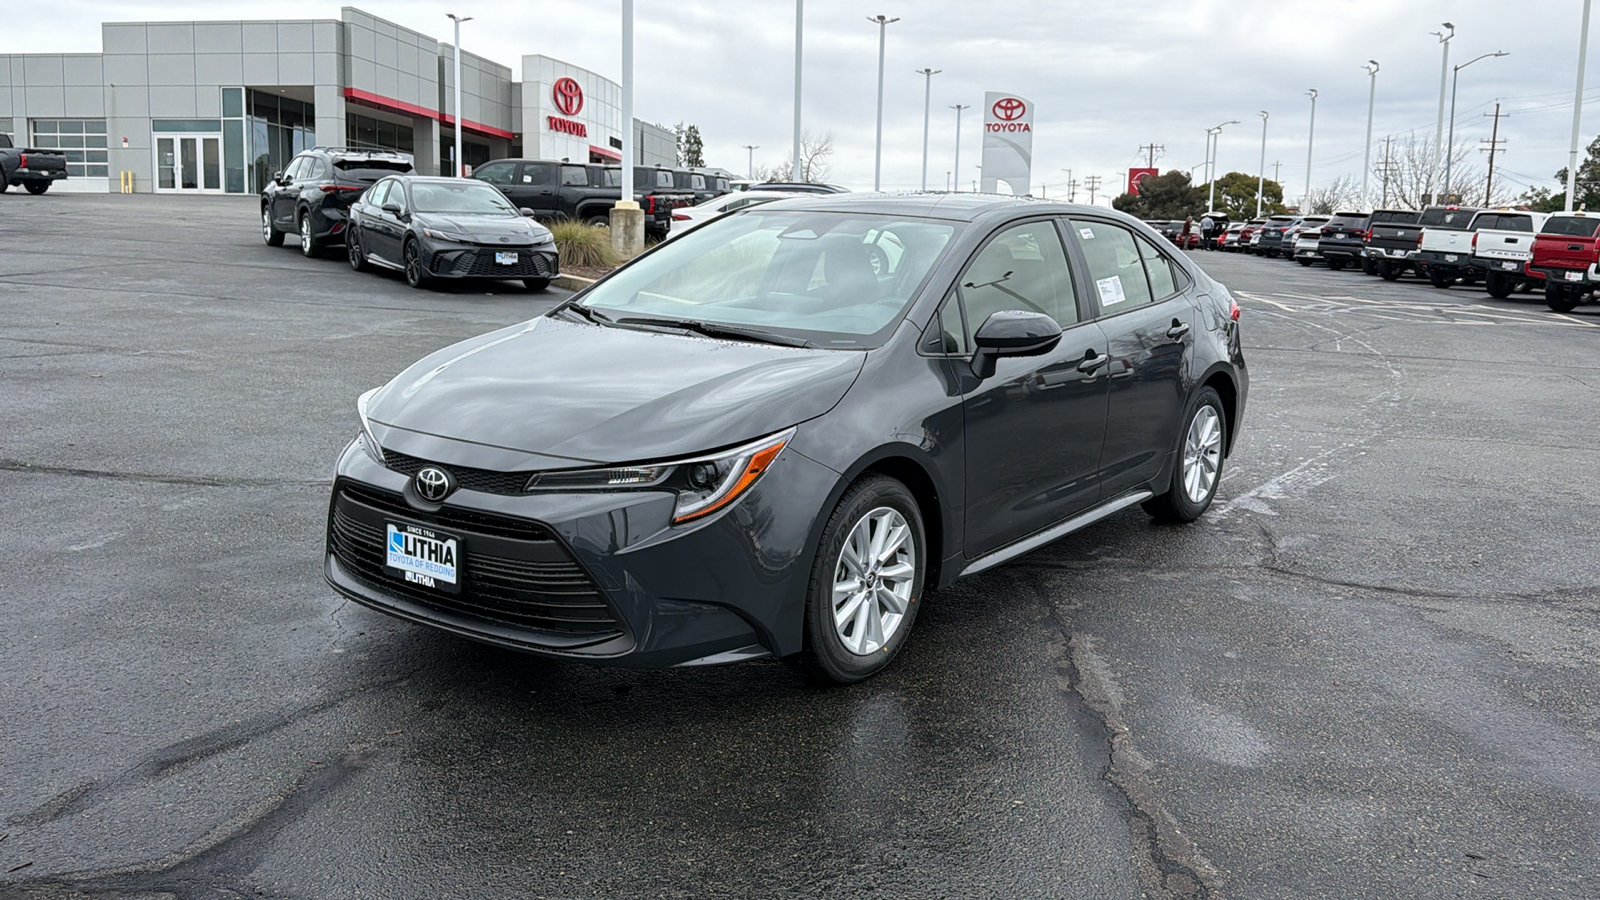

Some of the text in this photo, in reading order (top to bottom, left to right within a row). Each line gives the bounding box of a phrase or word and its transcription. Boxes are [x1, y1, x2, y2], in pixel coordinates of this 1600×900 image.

[547, 115, 587, 138] TOYOTA
[985, 122, 1031, 132] TOYOTA
[406, 525, 435, 538] SINCE 1946
[404, 535, 455, 567] LITHIA
[389, 552, 455, 578] TOYOTA OF REDDING
[413, 572, 435, 588] LITHIA
